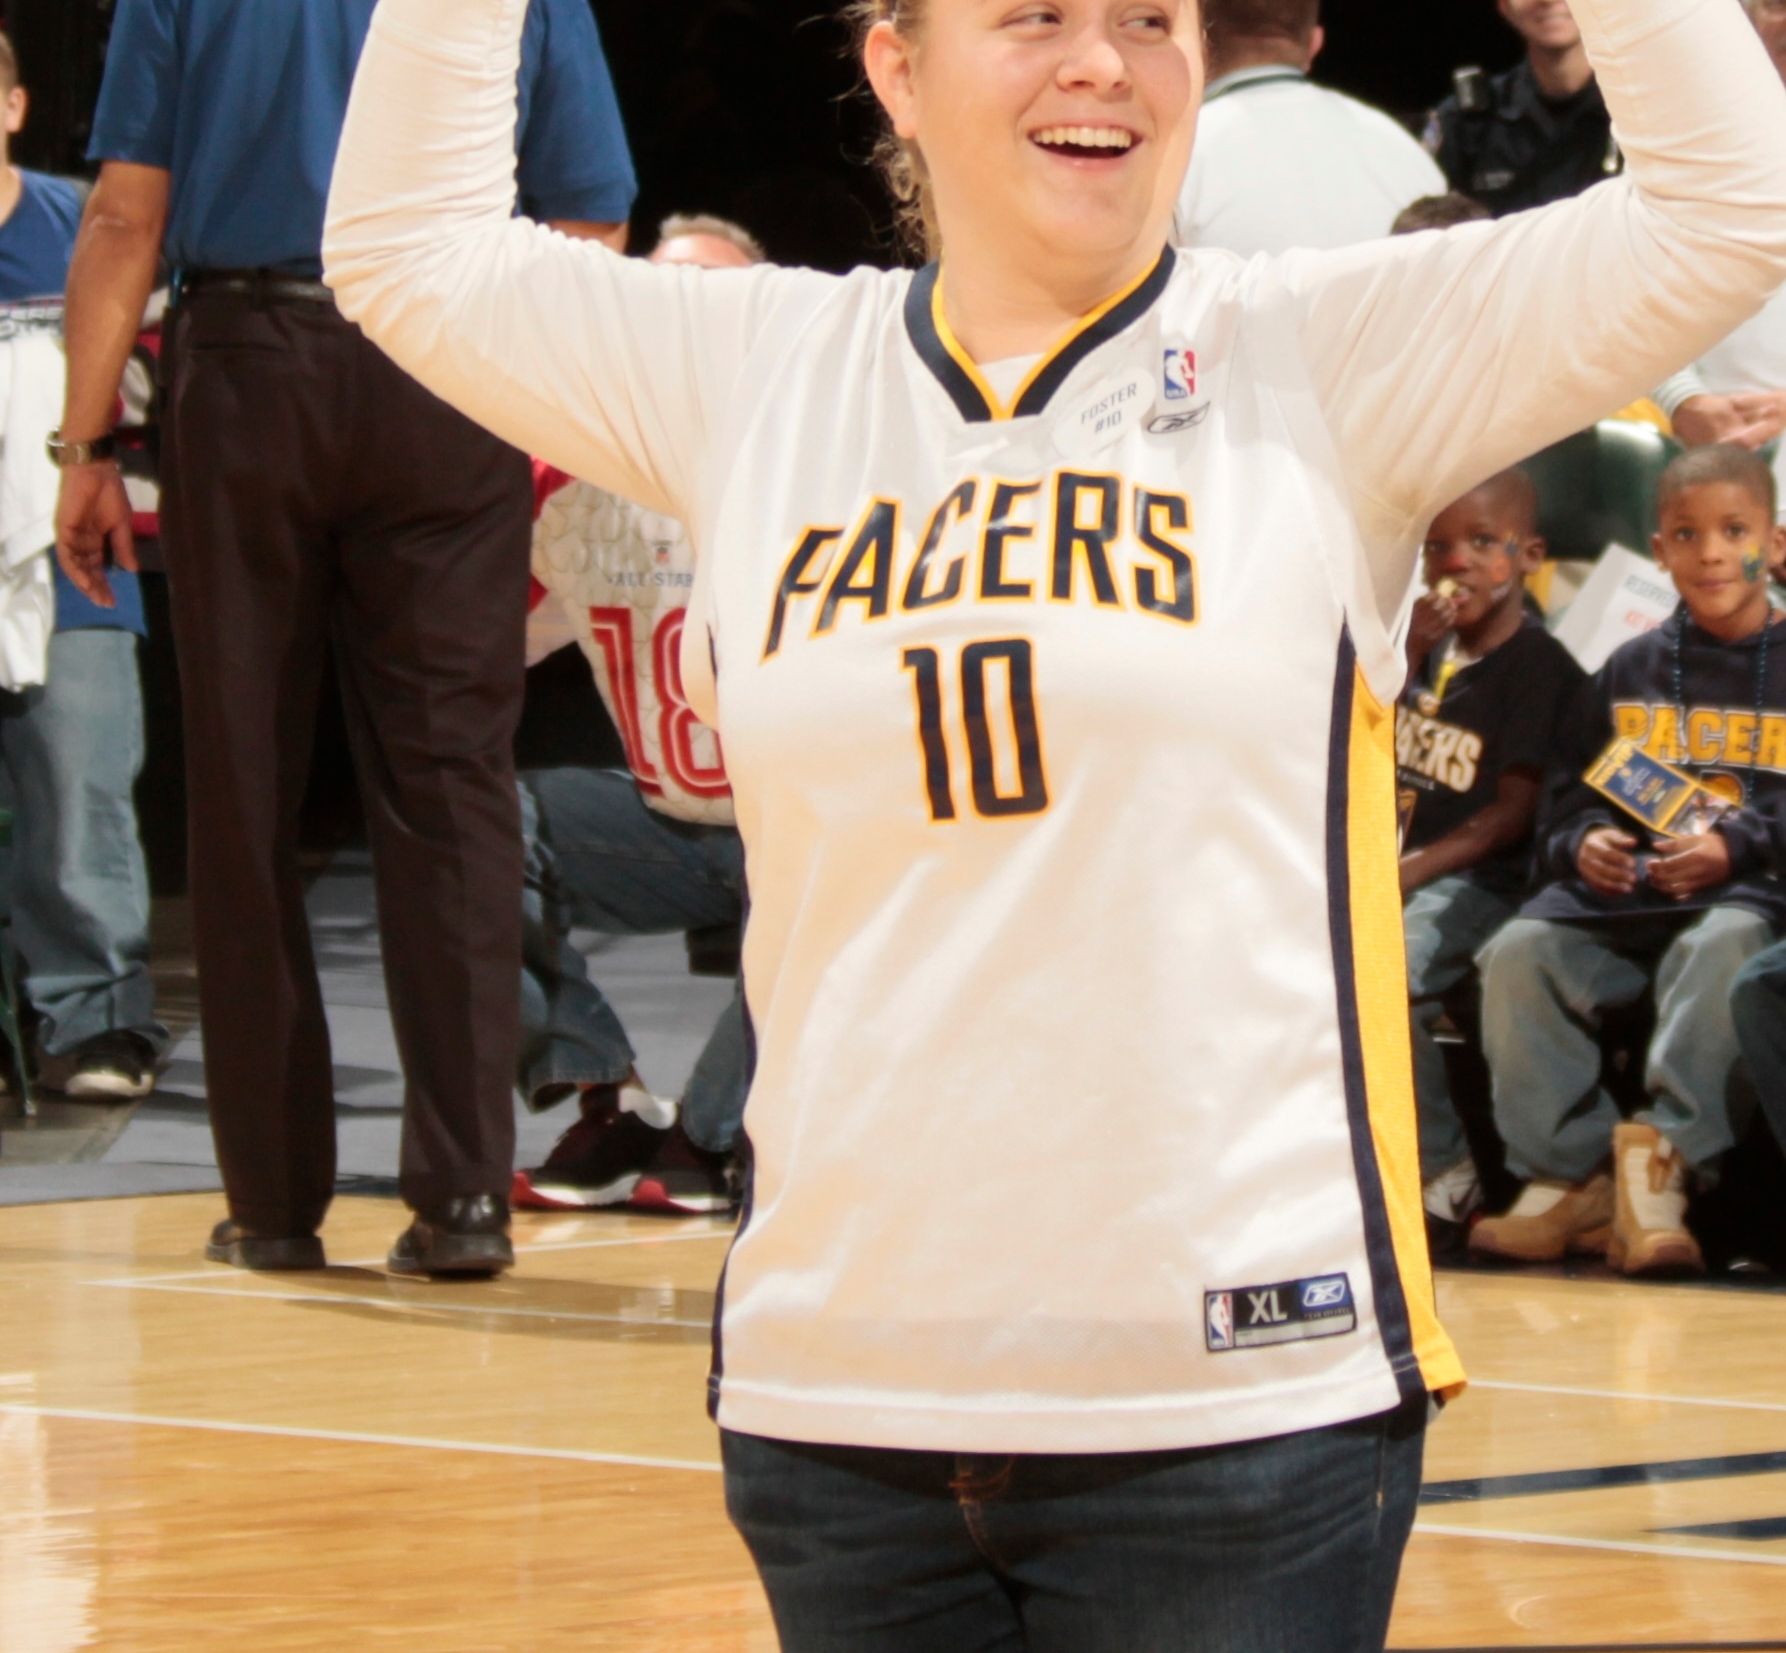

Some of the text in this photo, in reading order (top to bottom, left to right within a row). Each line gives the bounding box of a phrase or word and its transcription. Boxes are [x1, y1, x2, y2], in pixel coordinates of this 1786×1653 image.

[1081, 382, 1138, 426] FOSTER
[1094, 410, 1122, 434] #10
[759, 467, 1200, 666] PACERS
[901, 635, 1049, 825] 10
[1248, 1289, 1289, 1326] XL
